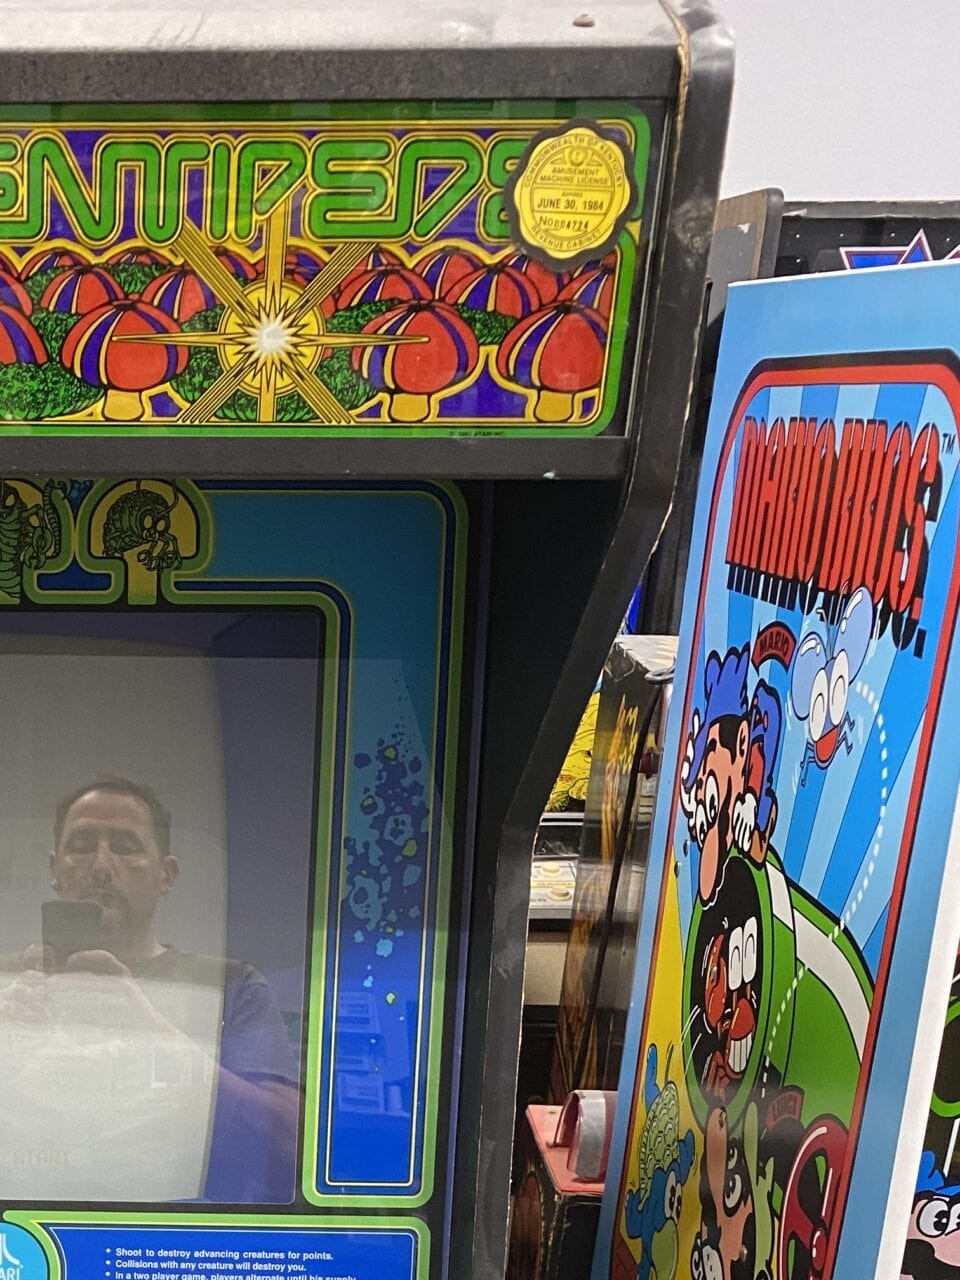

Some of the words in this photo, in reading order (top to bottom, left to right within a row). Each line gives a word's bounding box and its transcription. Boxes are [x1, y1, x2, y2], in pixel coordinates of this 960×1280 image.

[587, 138, 600, 147] OF
[599, 142, 623, 188] KENTUCKY
[551, 167, 600, 176] AMUSEMENT
[540, 174, 574, 183] MACHINE
[577, 176, 609, 185] LICENSE
[537, 198, 561, 209] JUNE
[564, 199, 578, 211] 30,
[583, 200, 604, 210] 1984
[531, 225, 565, 249] REVENUE
[566, 228, 601, 248] CABINET
[725, 416, 838, 600] MARIO
[941, 433, 956, 455] TM
[759, 630, 790, 658] MARIO
[115, 1247, 142, 1257] Shoot
[145, 1248, 155, 1257] to
[157, 1248, 191, 1259] destroy
[193, 1249, 240, 1260] advancing
[242, 1251, 285, 1260] creatures
[287, 1251, 301, 1260] for
[302, 1251, 334, 1262] points.
[115, 1259, 159, 1269] Collisions
[159, 1260, 179, 1269] with
[179, 1261, 197, 1271] any
[197, 1261, 234, 1270] creature
[235, 1261, 251, 1270] will
[252, 1262, 286, 1273] destroy
[287, 1264, 307, 1273] you.
[115, 1271, 124, 1280] In
[133, 1272, 150, 1280] two
